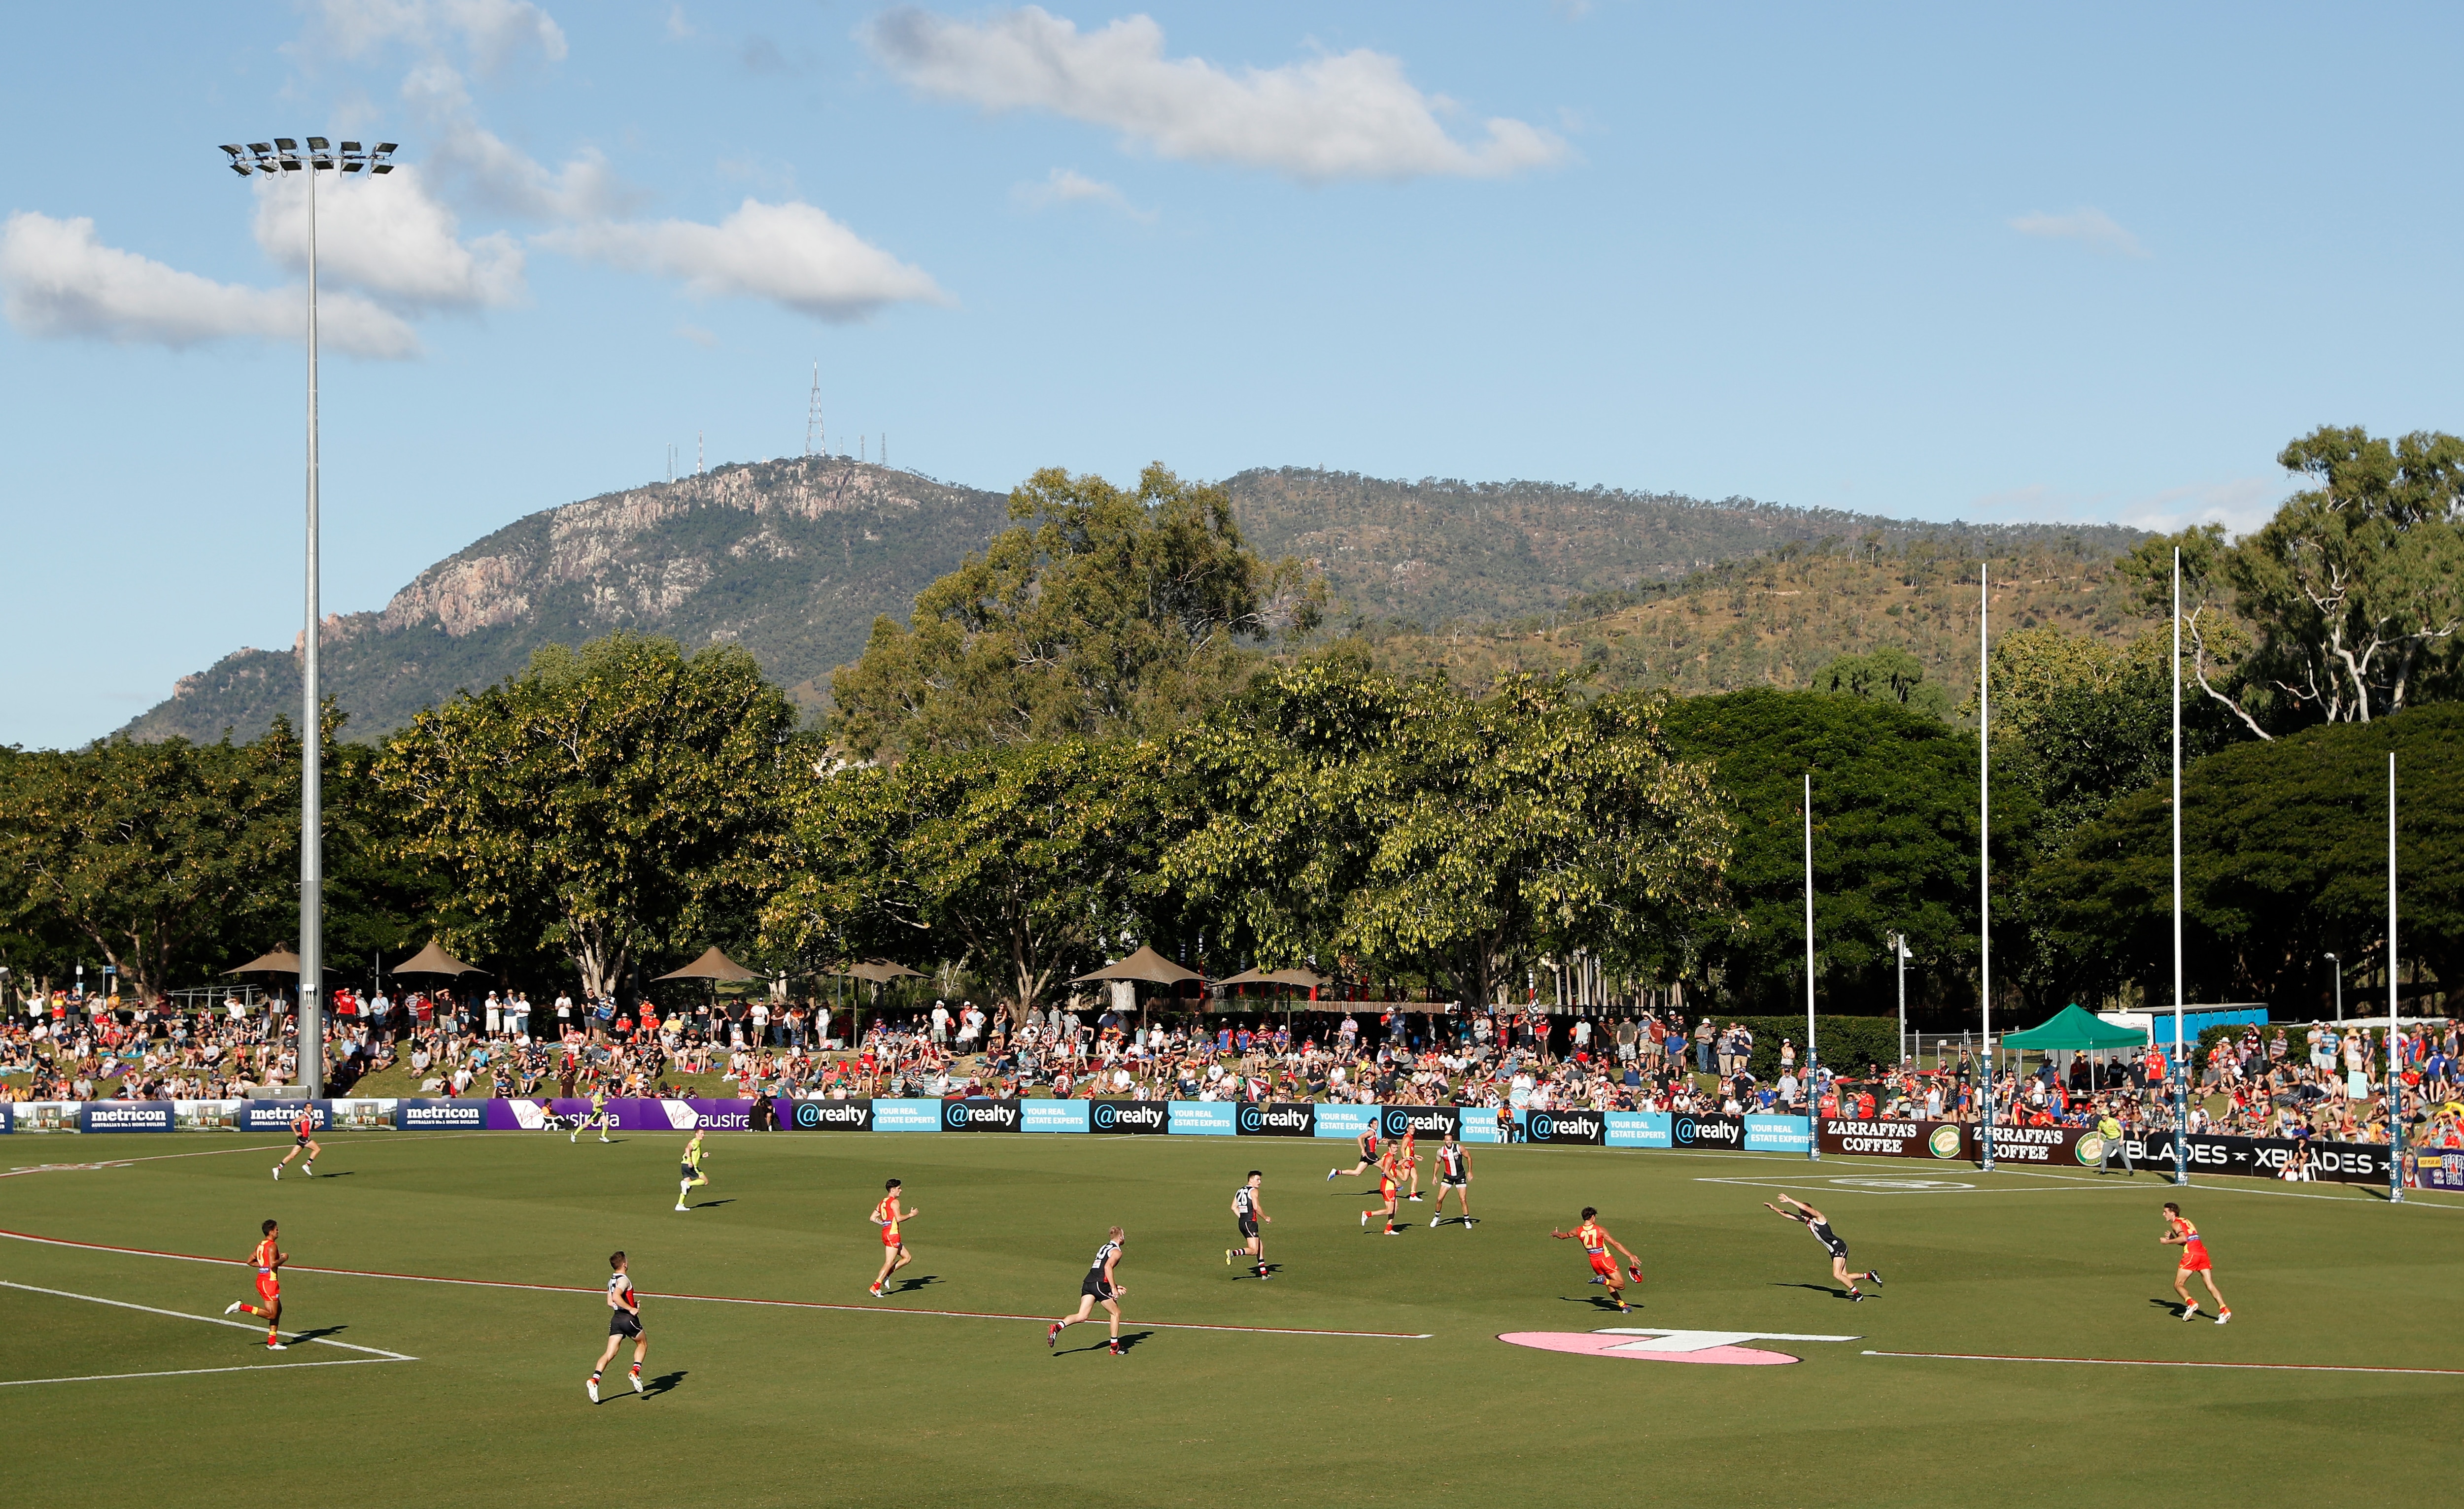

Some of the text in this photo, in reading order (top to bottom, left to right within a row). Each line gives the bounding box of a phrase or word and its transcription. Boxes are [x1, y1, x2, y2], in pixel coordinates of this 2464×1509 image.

[91, 1106, 167, 1121] metricon
[250, 1104, 324, 1119] metricn
[407, 1103, 479, 1118] metricon
[518, 1105, 542, 1126] Virgin
[671, 1105, 693, 1126] Virgin
[698, 1112, 750, 1127] austra
[797, 1103, 867, 1127] @realty
[946, 1103, 1016, 1127] @realty
[1094, 1104, 1163, 1128] @realty
[1241, 1107, 1309, 1131] @realty
[1346, 1122, 1369, 1131] EXPER
[1386, 1110, 1455, 1135] @realty
[1466, 1126, 1490, 1134] ESTATE
[1531, 1114, 1600, 1140] @realty
[1676, 1118, 1739, 1144] @realty
[1751, 1124, 1792, 1133] YOUR REAL
[1827, 1121, 1917, 1138] ZARRAFFA'S
[1637, 1131, 1666, 1139] EXPERTS
[1751, 1134, 1810, 1144] ESTATE EXPERTS
[1973, 1126, 2063, 1144] ZRRAFFA'S
[1842, 1137, 1903, 1153] COFFEE
[1237, 1188, 1248, 1206] 26
[881, 1202, 888, 1220] 6
[1580, 1229, 1597, 1249] 27
